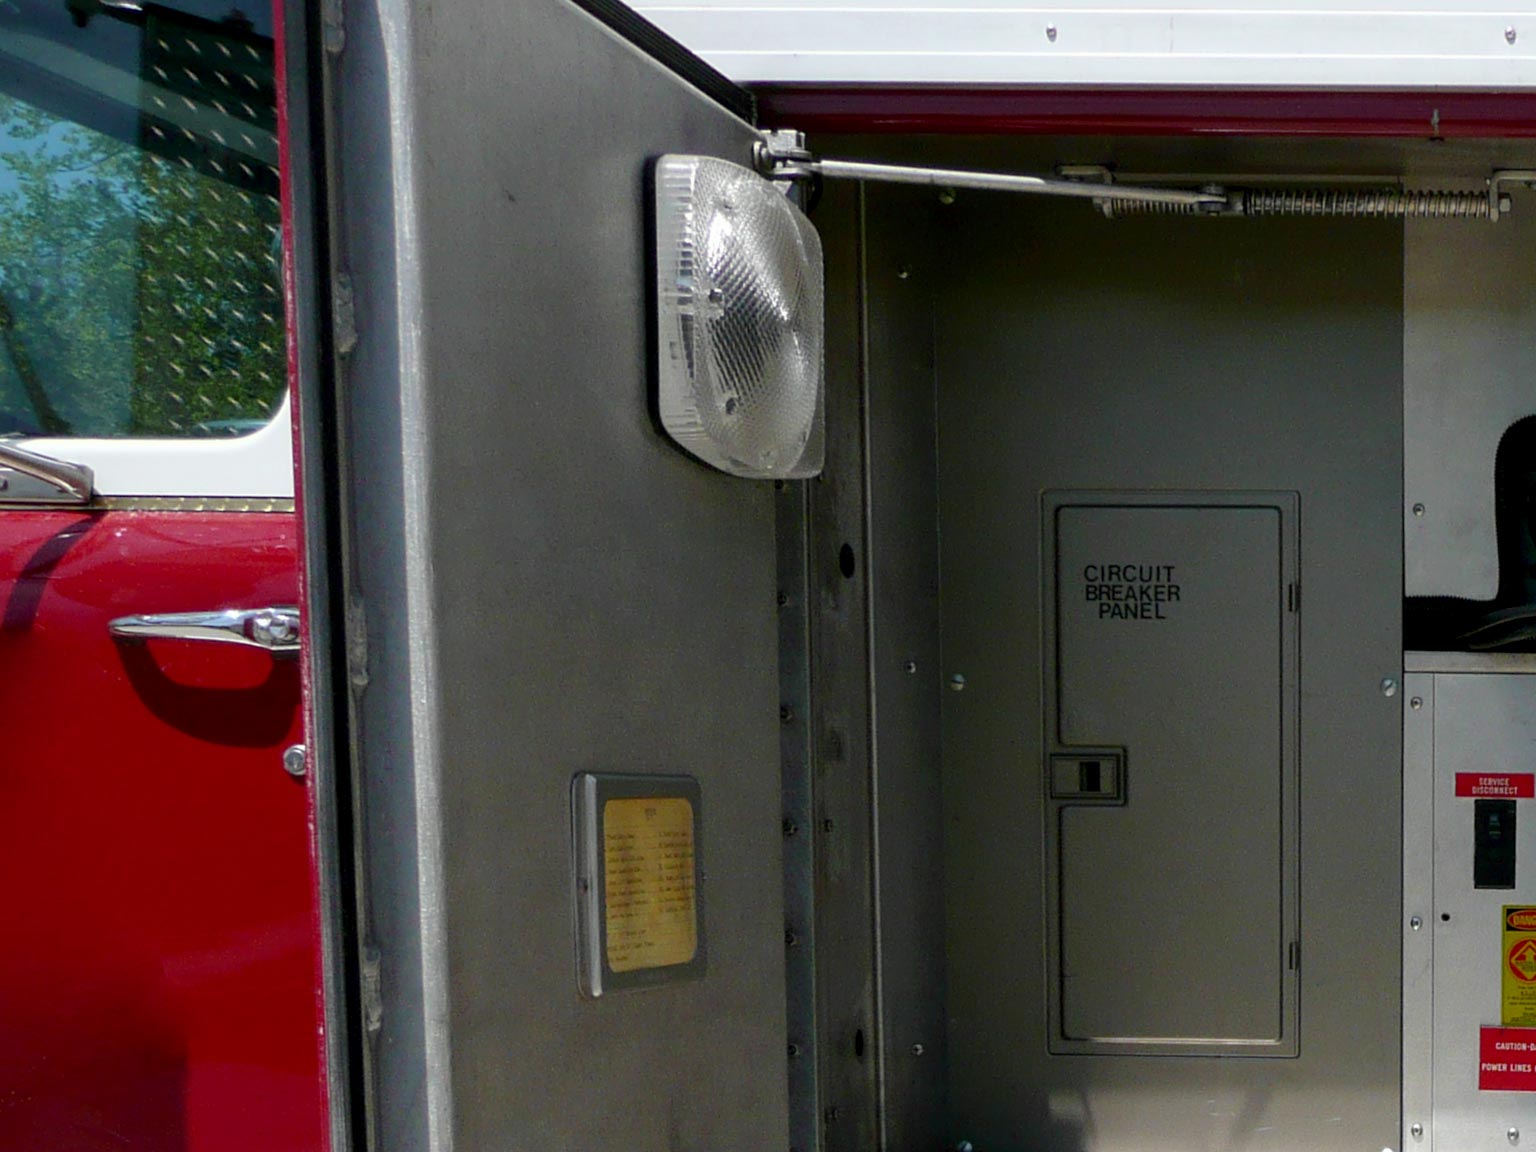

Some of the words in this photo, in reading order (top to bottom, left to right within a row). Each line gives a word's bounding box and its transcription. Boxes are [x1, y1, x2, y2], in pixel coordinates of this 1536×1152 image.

[1084, 565, 1175, 582] CIRCUIT
[1085, 584, 1181, 602] BREAKER
[1099, 603, 1166, 619] PANEL
[1478, 777, 1510, 786] SERVICE
[1472, 786, 1519, 795] DISCONNECT
[1481, 1062, 1507, 1072] POWER
[1510, 1063, 1532, 1072] LINES
